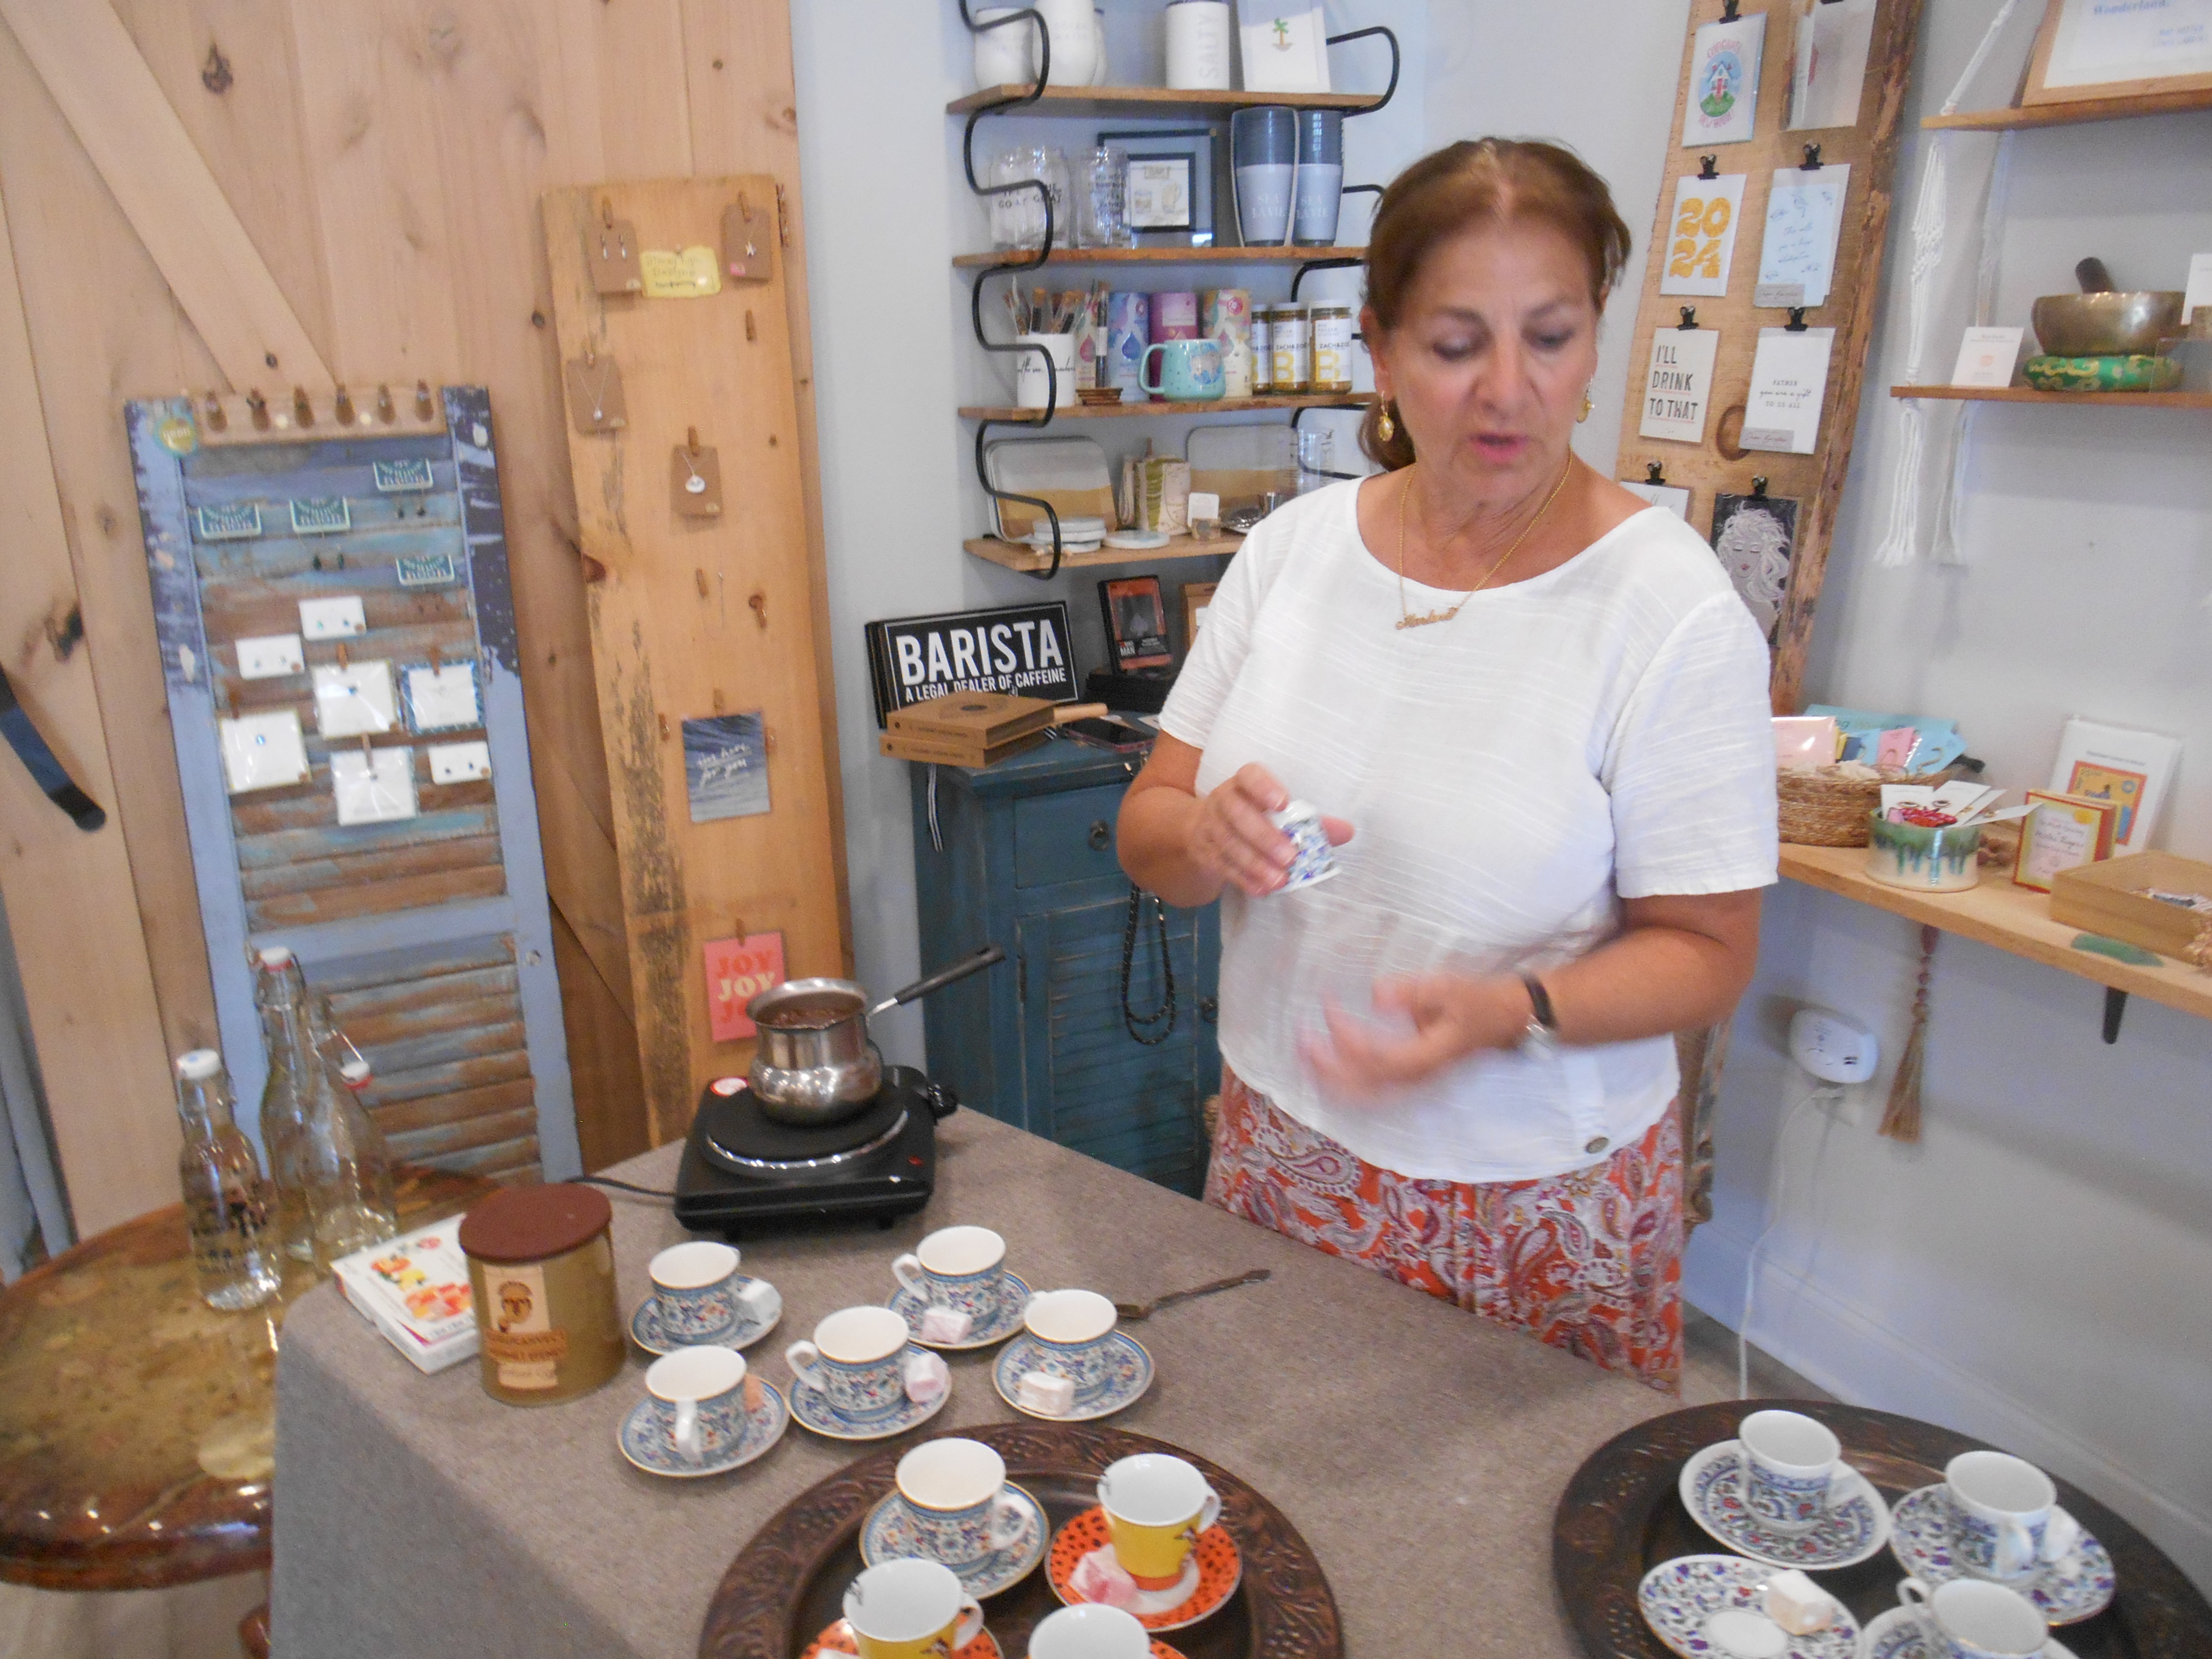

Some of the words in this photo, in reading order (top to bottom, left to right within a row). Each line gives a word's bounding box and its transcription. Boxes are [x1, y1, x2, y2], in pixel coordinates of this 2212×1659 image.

[1197, 12, 1219, 79] SALTY
[1676, 197, 1731, 238] 20
[1669, 239, 1721, 279] 24
[1656, 345, 1677, 364] I'LL
[1652, 371, 1693, 391] DRINK
[1650, 398, 1663, 416] TO
[1668, 400, 1698, 420] THAT
[896, 619, 1063, 686] BARISTA
[905, 688, 914, 702] A
[998, 674, 1012, 690] OF
[1016, 668, 1066, 687] CAFFEINE
[717, 950, 775, 979] JOY
[718, 972, 775, 1002] JOY
